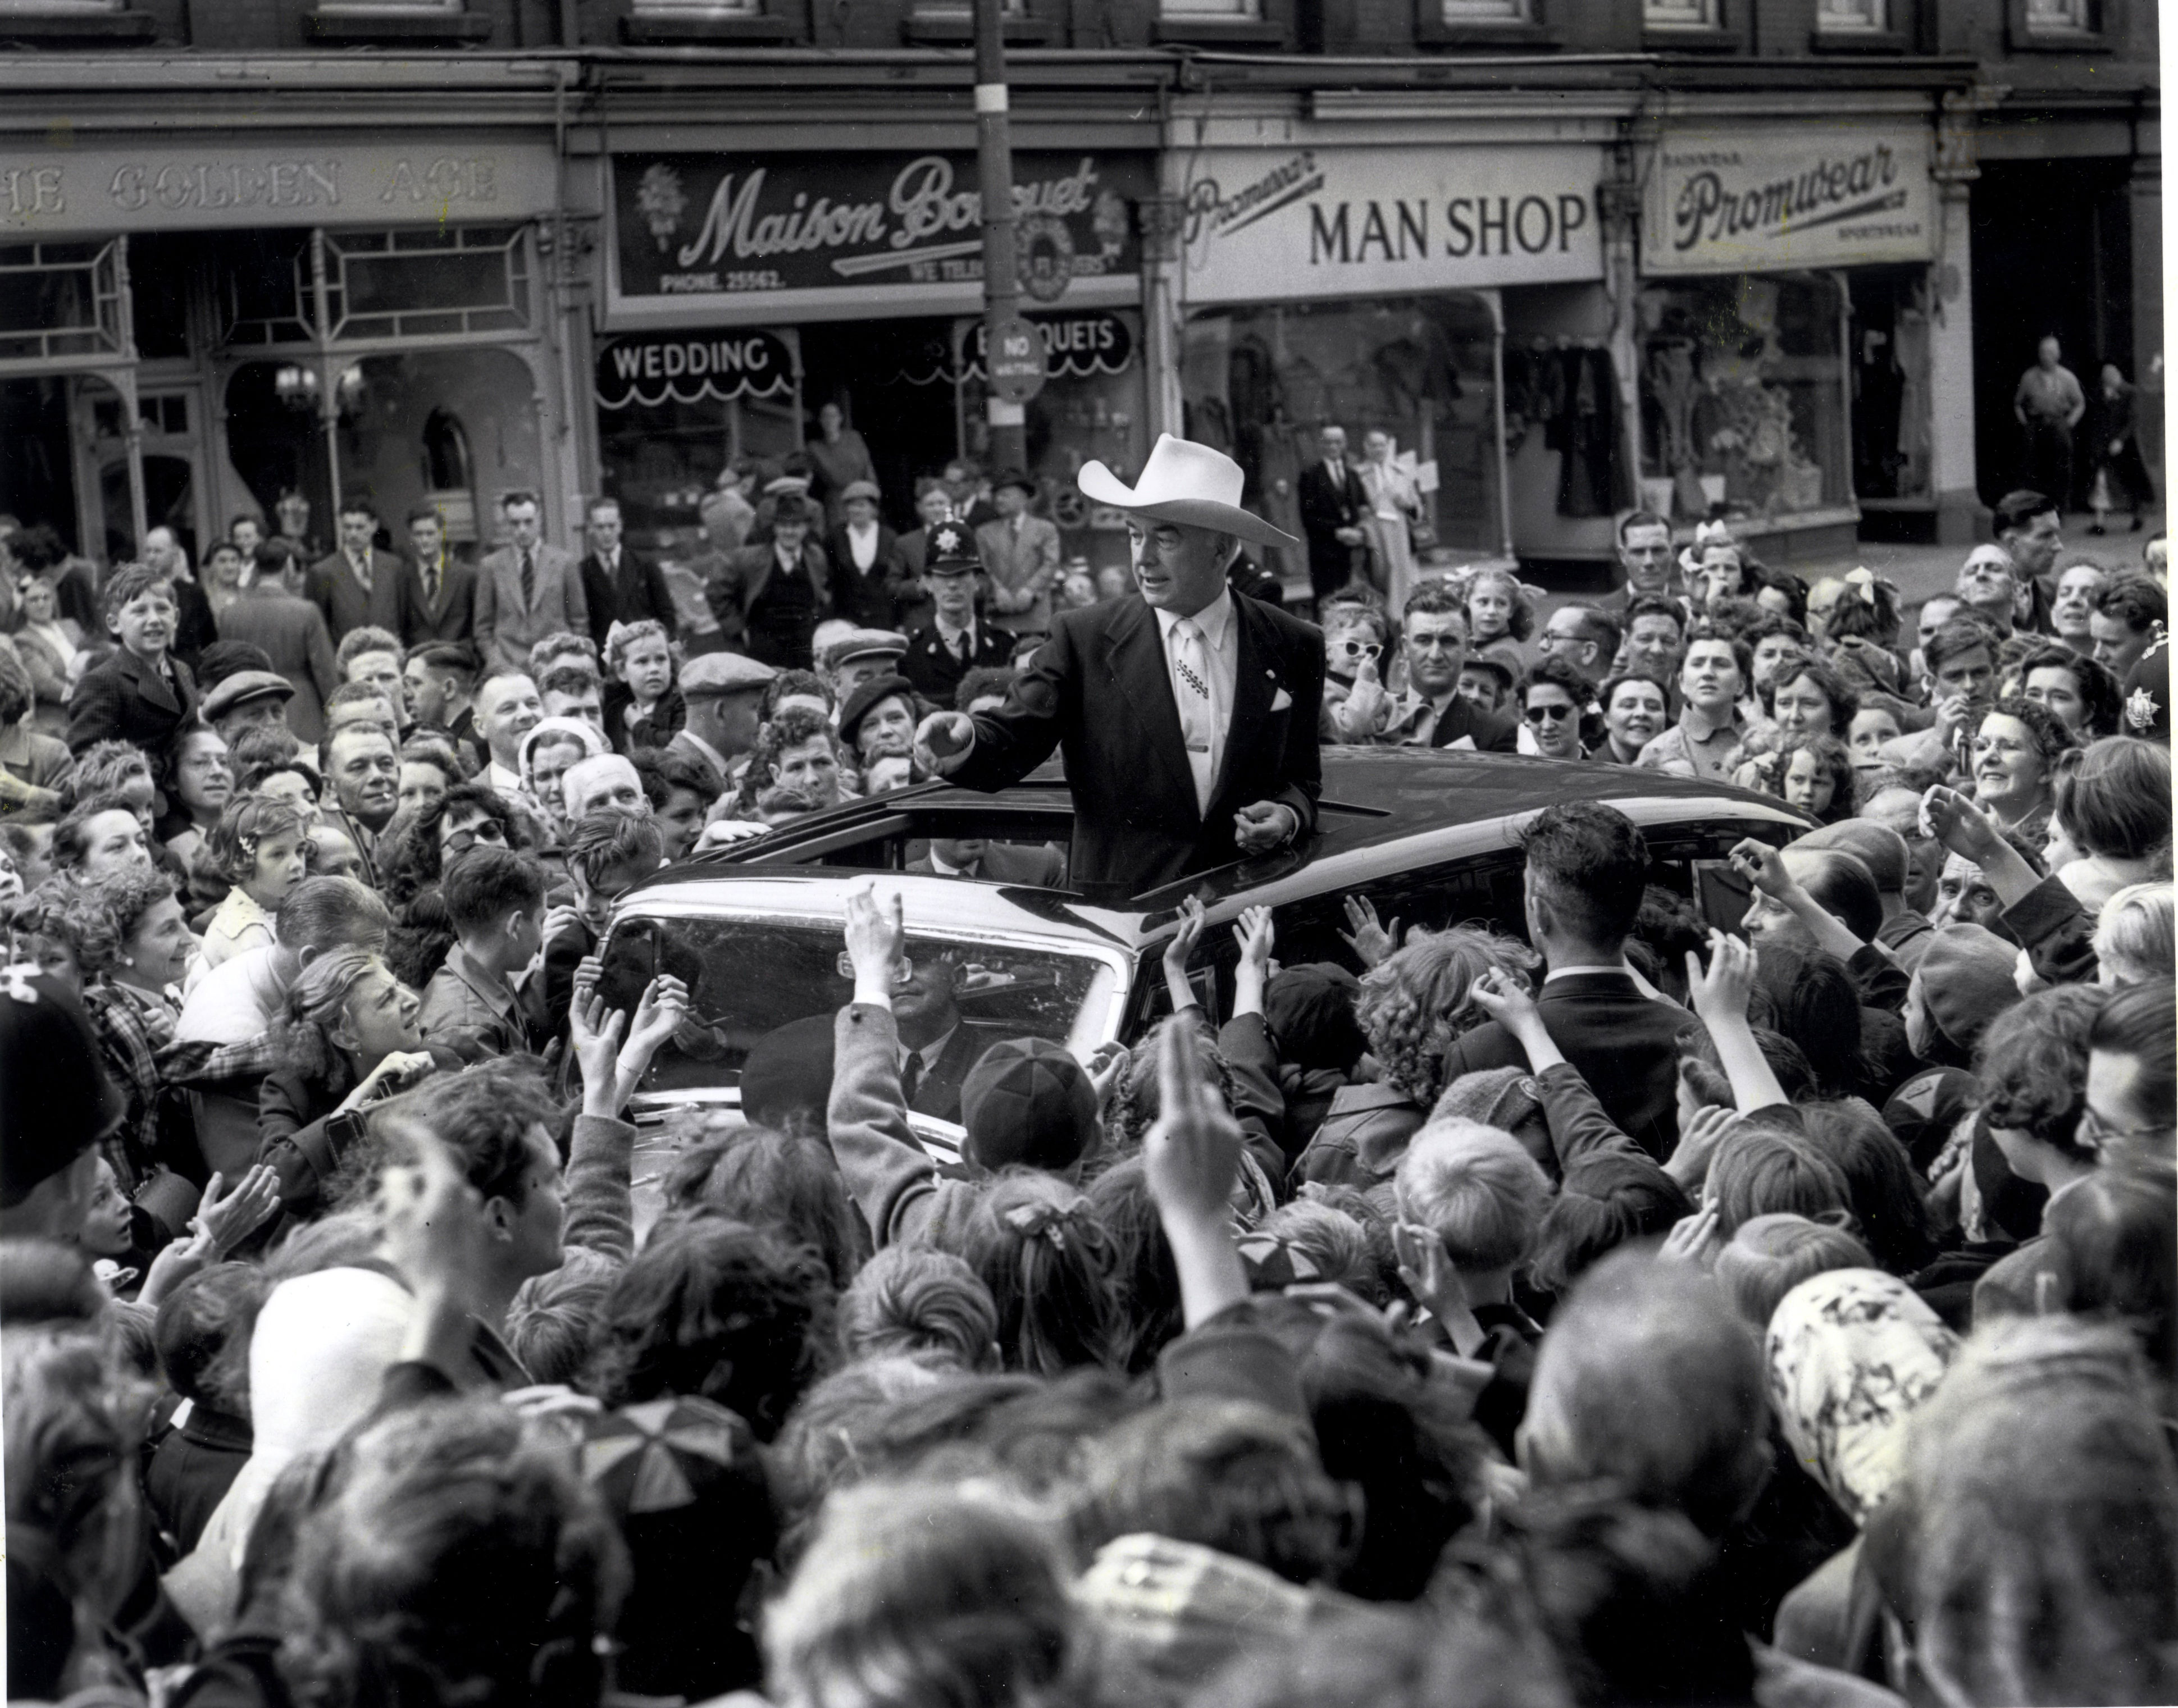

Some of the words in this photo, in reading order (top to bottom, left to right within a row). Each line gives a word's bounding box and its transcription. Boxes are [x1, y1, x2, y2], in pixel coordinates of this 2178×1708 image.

[109, 158, 341, 212] GOLDEN
[380, 156, 497, 203] AGE
[677, 168, 886, 268] Maison
[889, 156, 1099, 248] Boquet
[1309, 198, 1429, 265] MAN
[1446, 193, 1587, 257] SHOP
[612, 337, 769, 380] WEDDING
[976, 318, 1114, 357] QUETS
[1003, 336, 1029, 357] NO
